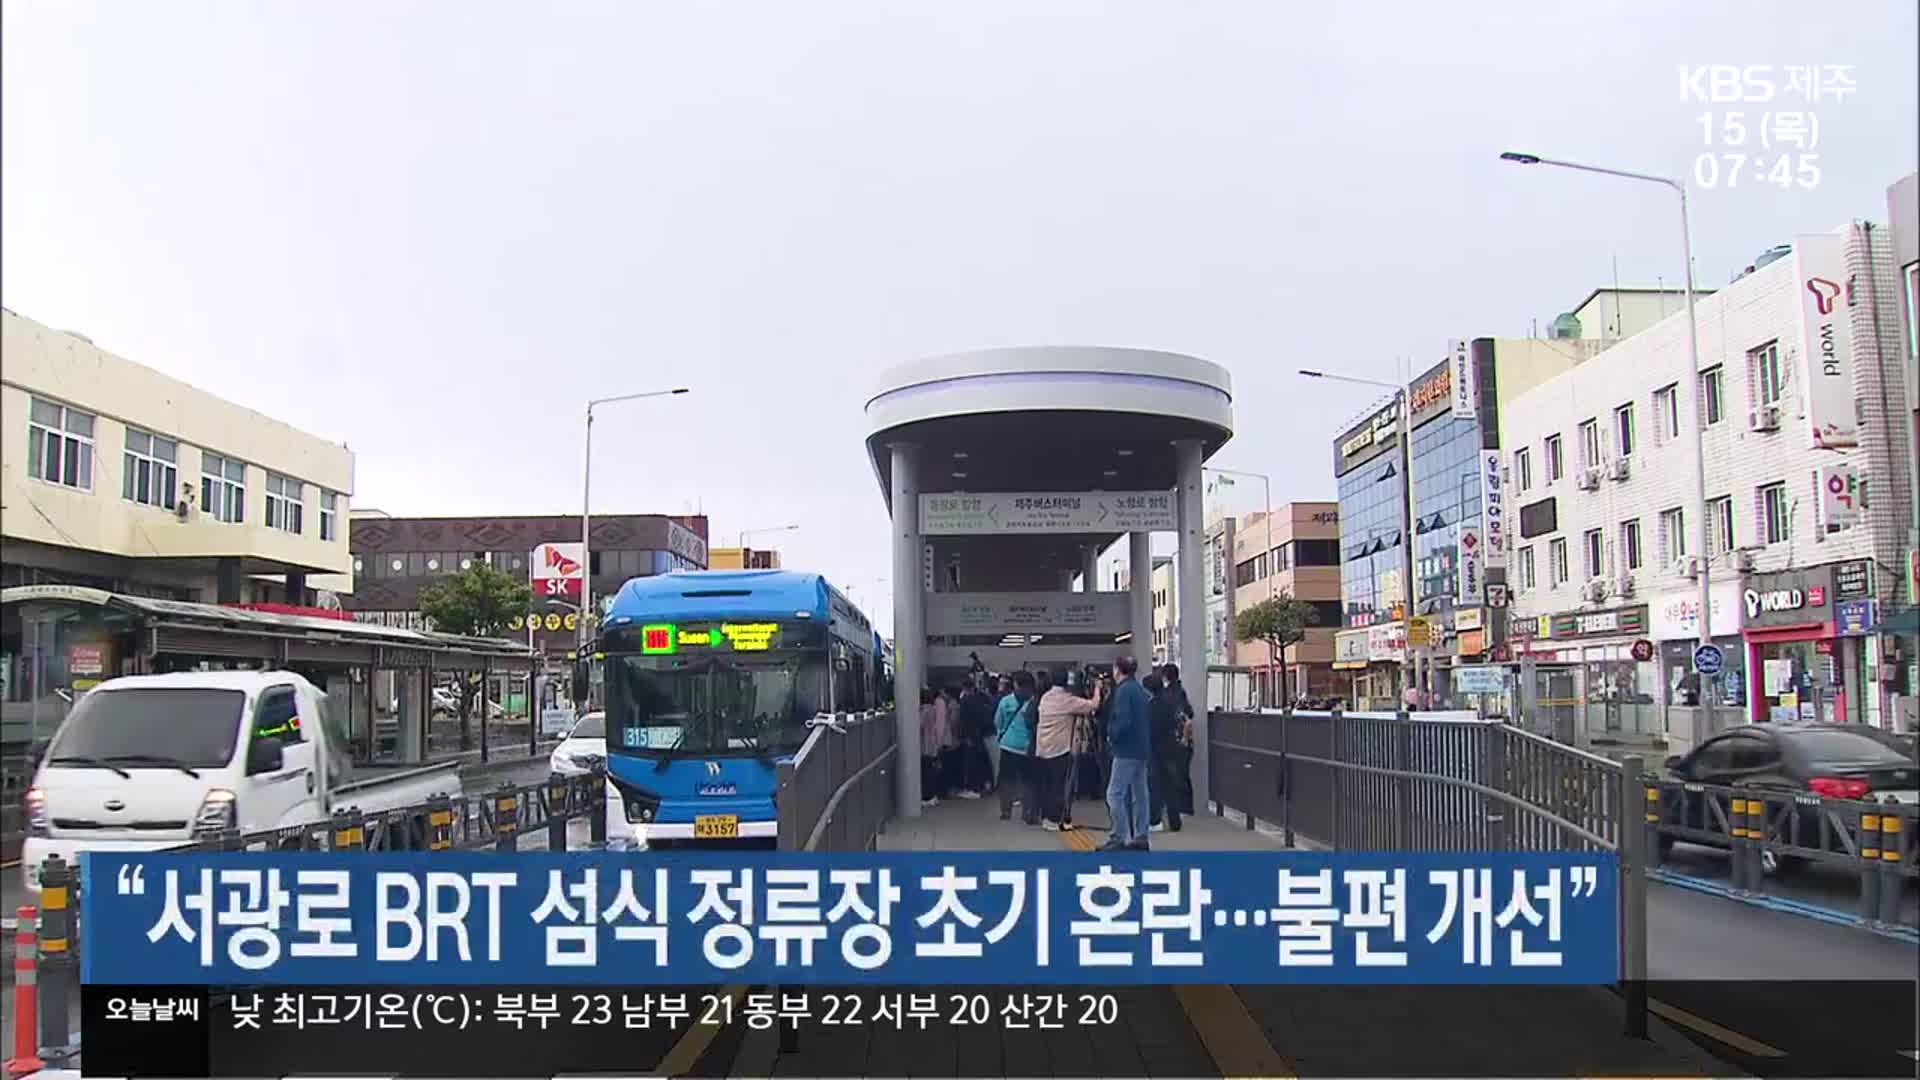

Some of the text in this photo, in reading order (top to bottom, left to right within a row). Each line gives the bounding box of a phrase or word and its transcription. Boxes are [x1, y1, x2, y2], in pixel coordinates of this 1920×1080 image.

[1819, 323, 1841, 377] world
[1828, 474, 1857, 509] 약
[1015, 497, 1081, 510] 제주버스터미널
[546, 579, 568, 595] SK
[1760, 589, 1803, 612] WORLD
[627, 728, 648, 746] 315
